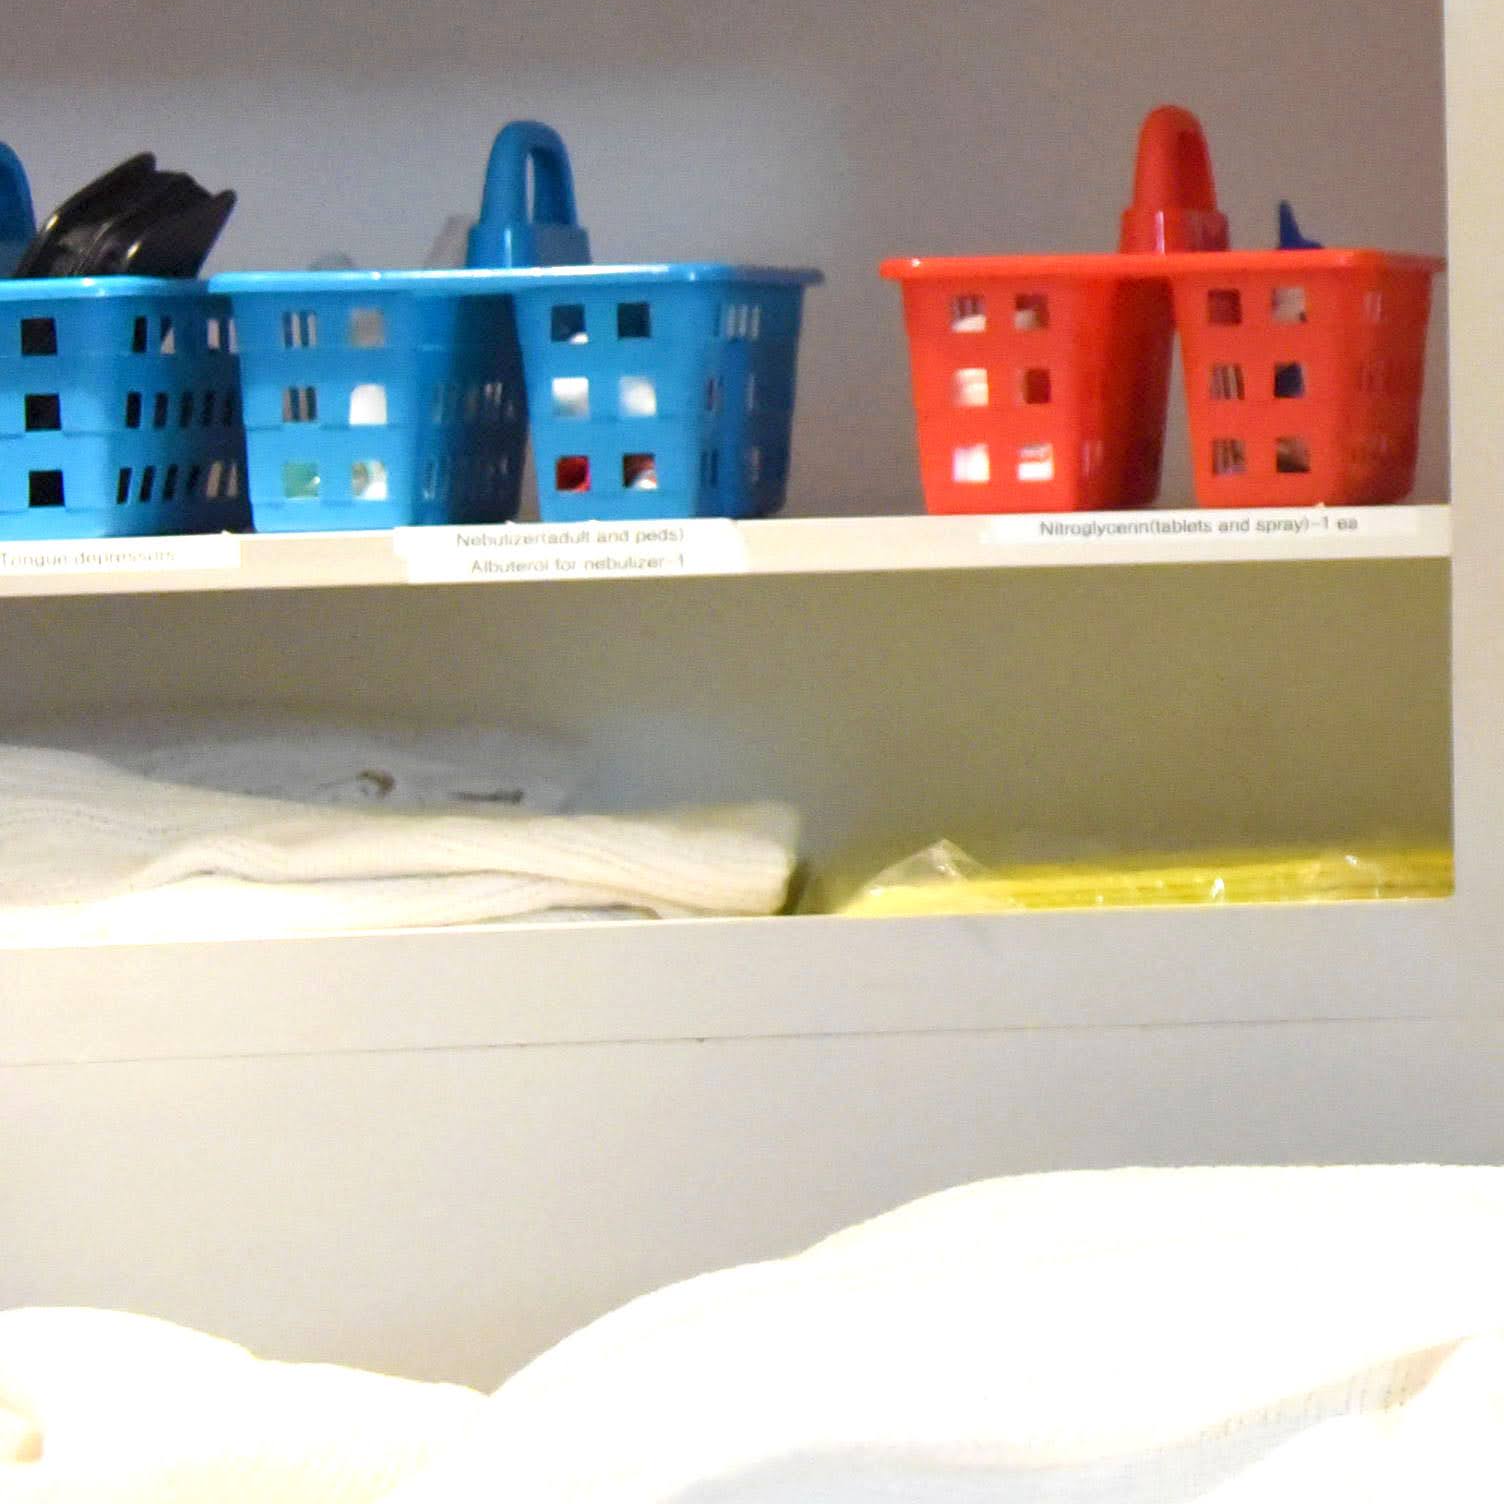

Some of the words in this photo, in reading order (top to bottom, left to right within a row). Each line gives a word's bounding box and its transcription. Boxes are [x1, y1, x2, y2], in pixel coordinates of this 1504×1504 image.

[1218, 518, 1250, 533] and
[1337, 518, 1358, 531] ea
[597, 528, 628, 543] and
[636, 528, 685, 545] peds)
[555, 557, 576, 571] for
